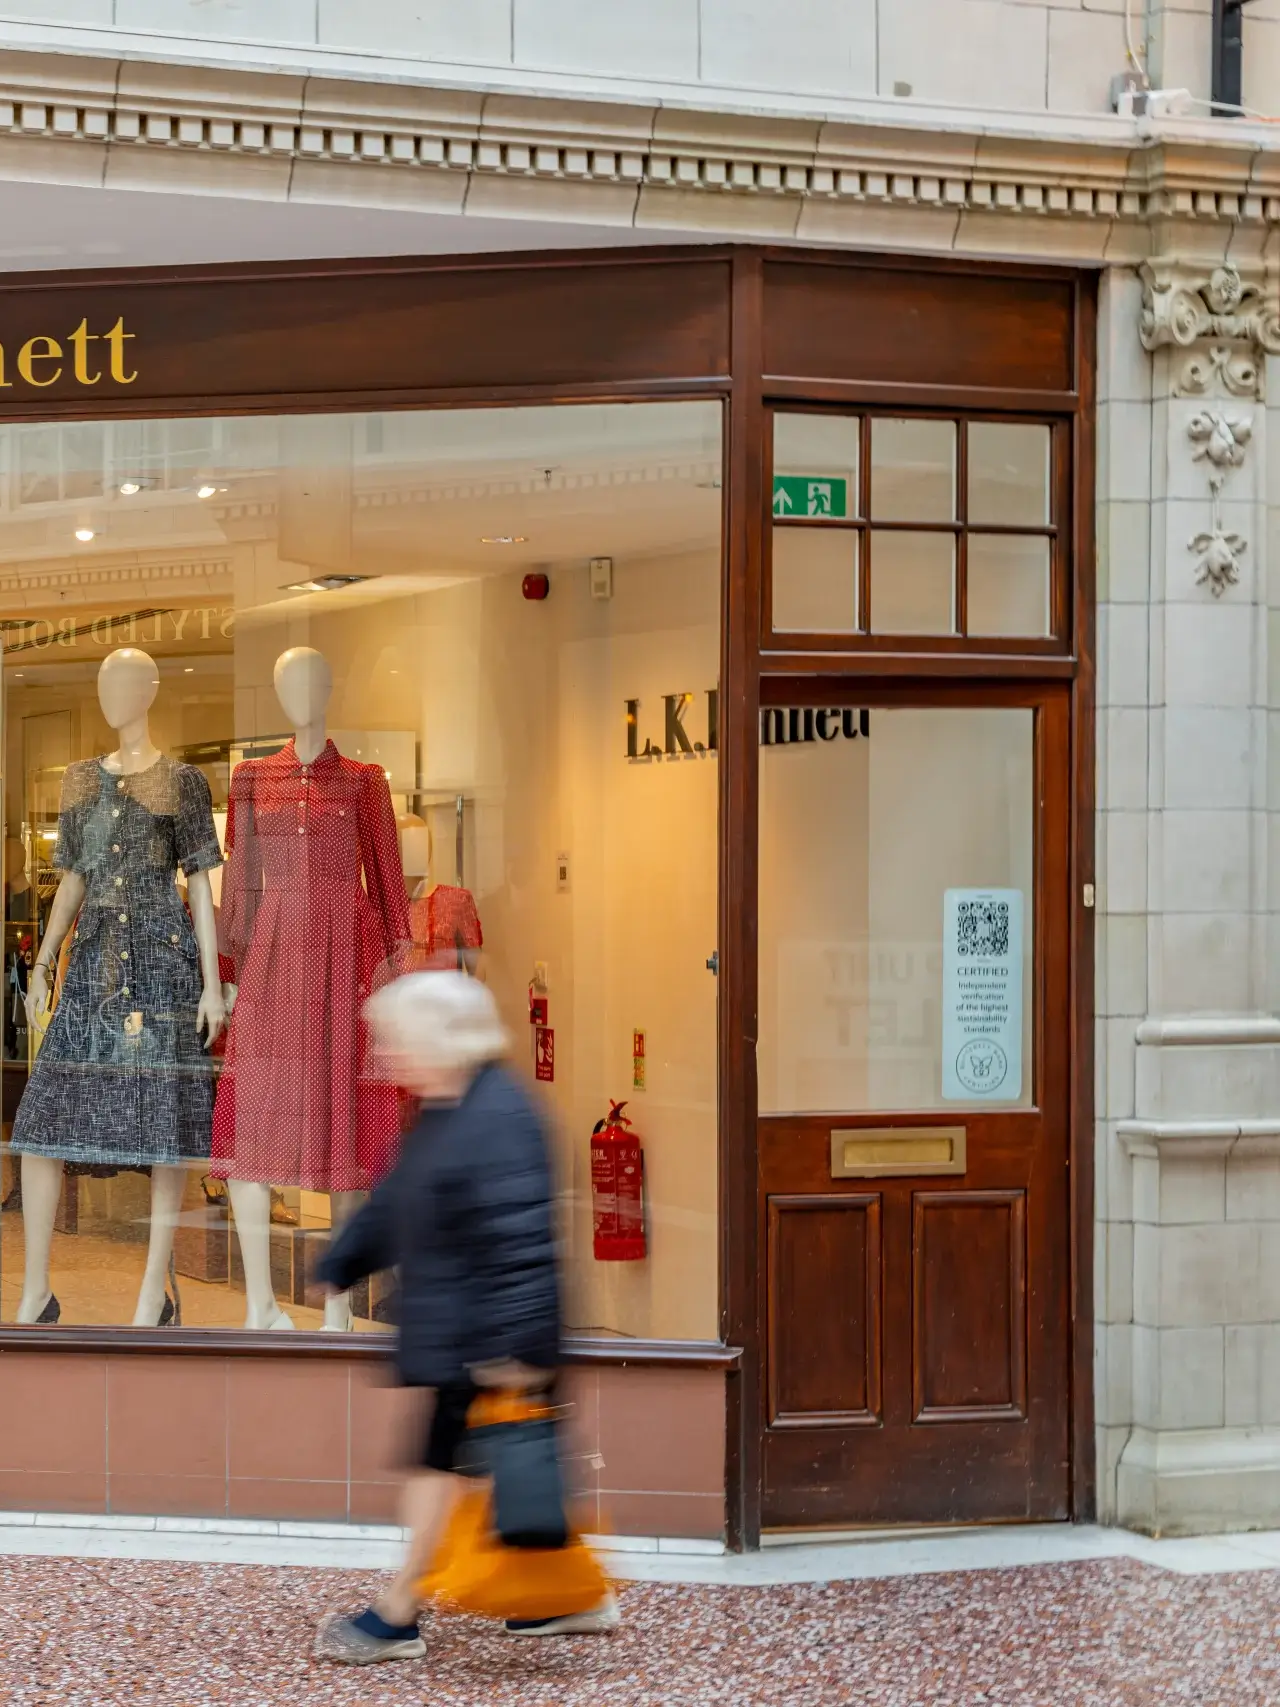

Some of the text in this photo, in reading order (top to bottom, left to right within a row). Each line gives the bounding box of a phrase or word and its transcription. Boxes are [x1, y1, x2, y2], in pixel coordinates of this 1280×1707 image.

[957, 967, 1009, 976] CERTIFIED
[958, 980, 1007, 990] Independent
[961, 992, 1004, 1000] verification
[956, 1003, 1008, 1013] of the highest
[957, 1014, 1008, 1024] sustainability
[963, 1025, 1001, 1033] standards
